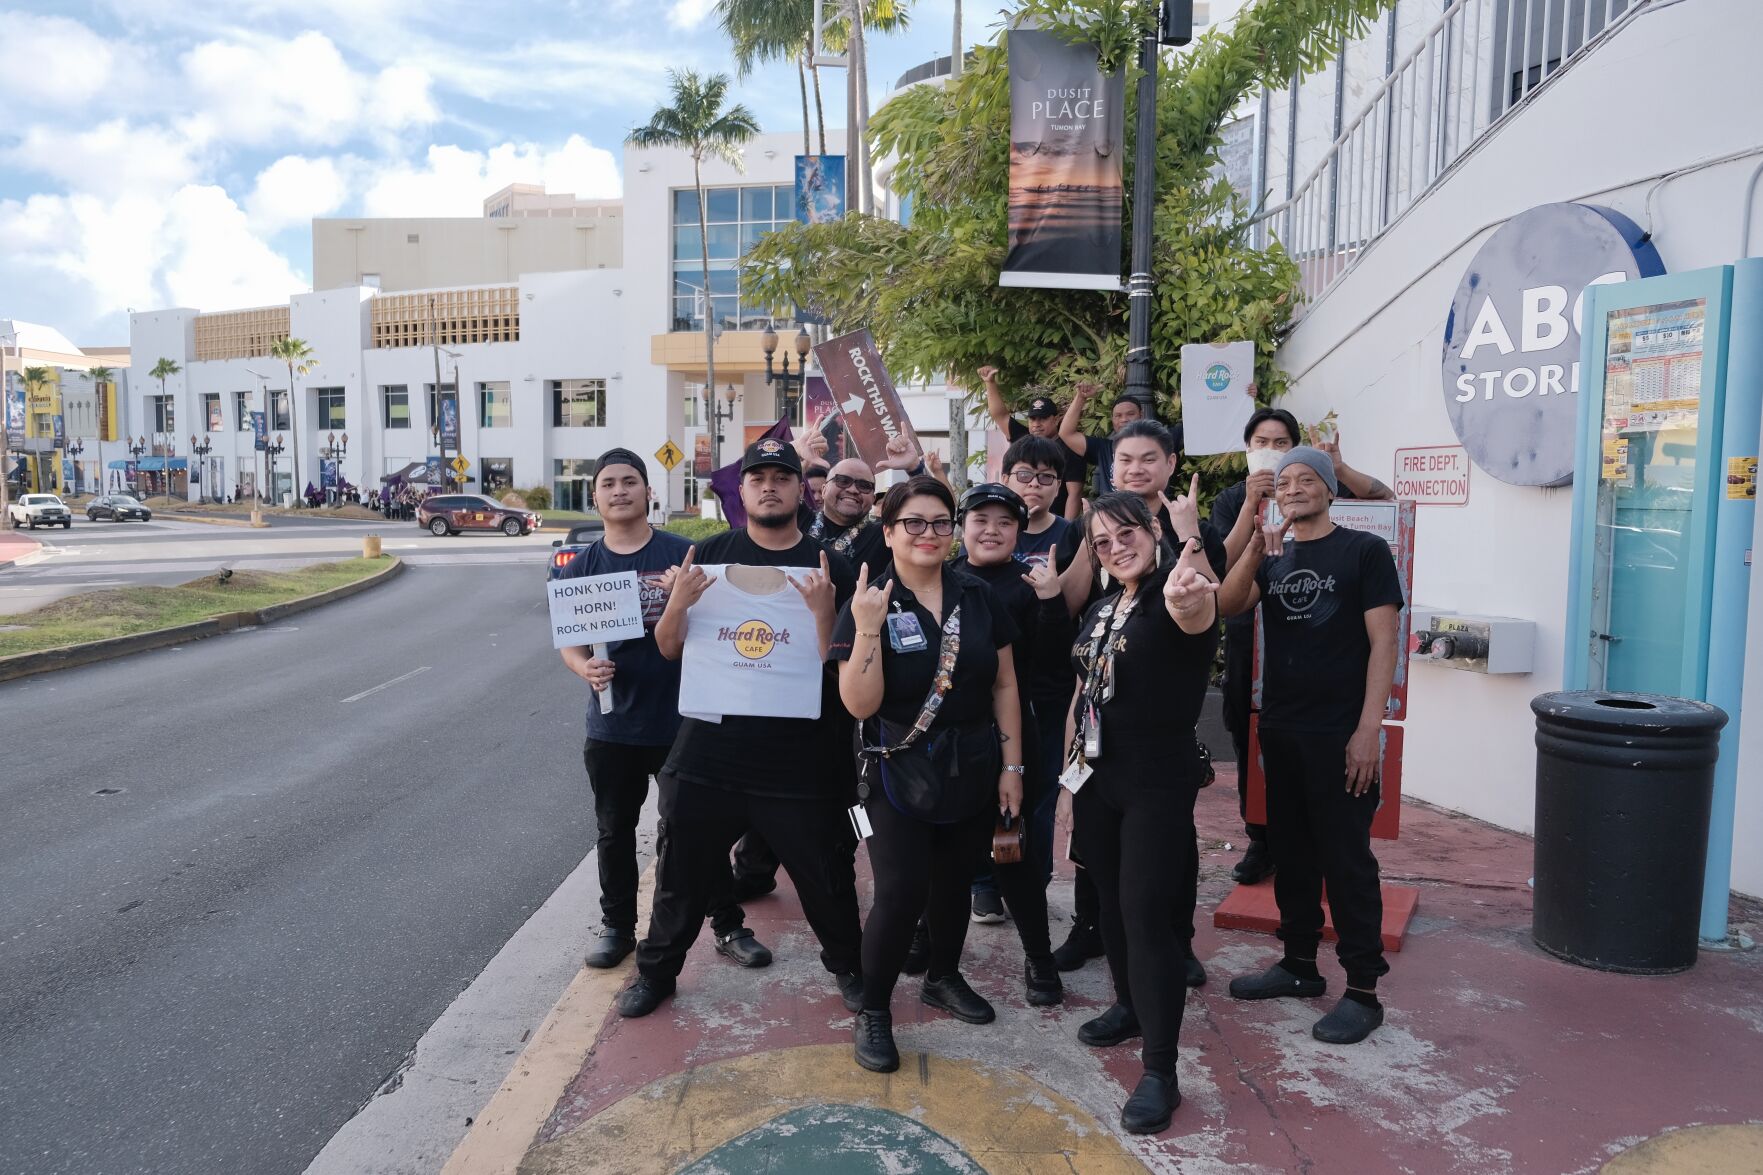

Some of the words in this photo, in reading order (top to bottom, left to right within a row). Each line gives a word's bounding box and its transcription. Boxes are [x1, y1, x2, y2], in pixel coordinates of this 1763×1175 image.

[1047, 88, 1091, 99] DUSIT
[1032, 99, 1105, 120] PLACE
[849, 347, 874, 386] ROCK
[866, 383, 888, 416] THIS
[880, 414, 901, 439] WA
[1403, 456, 1426, 472] FIRE
[1429, 454, 1459, 471] DEPT.
[1396, 479, 1466, 496] CONNECTION
[1328, 515, 1346, 523] usit
[1346, 515, 1369, 523] Beach
[554, 584, 593, 599] HONK
[595, 579, 632, 593] YOUR
[1267, 578, 1303, 595] Hard
[1301, 574, 1336, 594] Rock
[640, 586, 665, 602] ock
[574, 601, 617, 616] HORN!
[556, 622, 588, 635] ROCK
[590, 621, 598, 631] N
[600, 616, 638, 629] ROLL!!!
[1448, 623, 1469, 632] PLAZA
[717, 626, 755, 642] Hard
[755, 627, 791, 645] Rock
[744, 645, 763, 653] CAFE
[1071, 643, 1090, 657] Har
